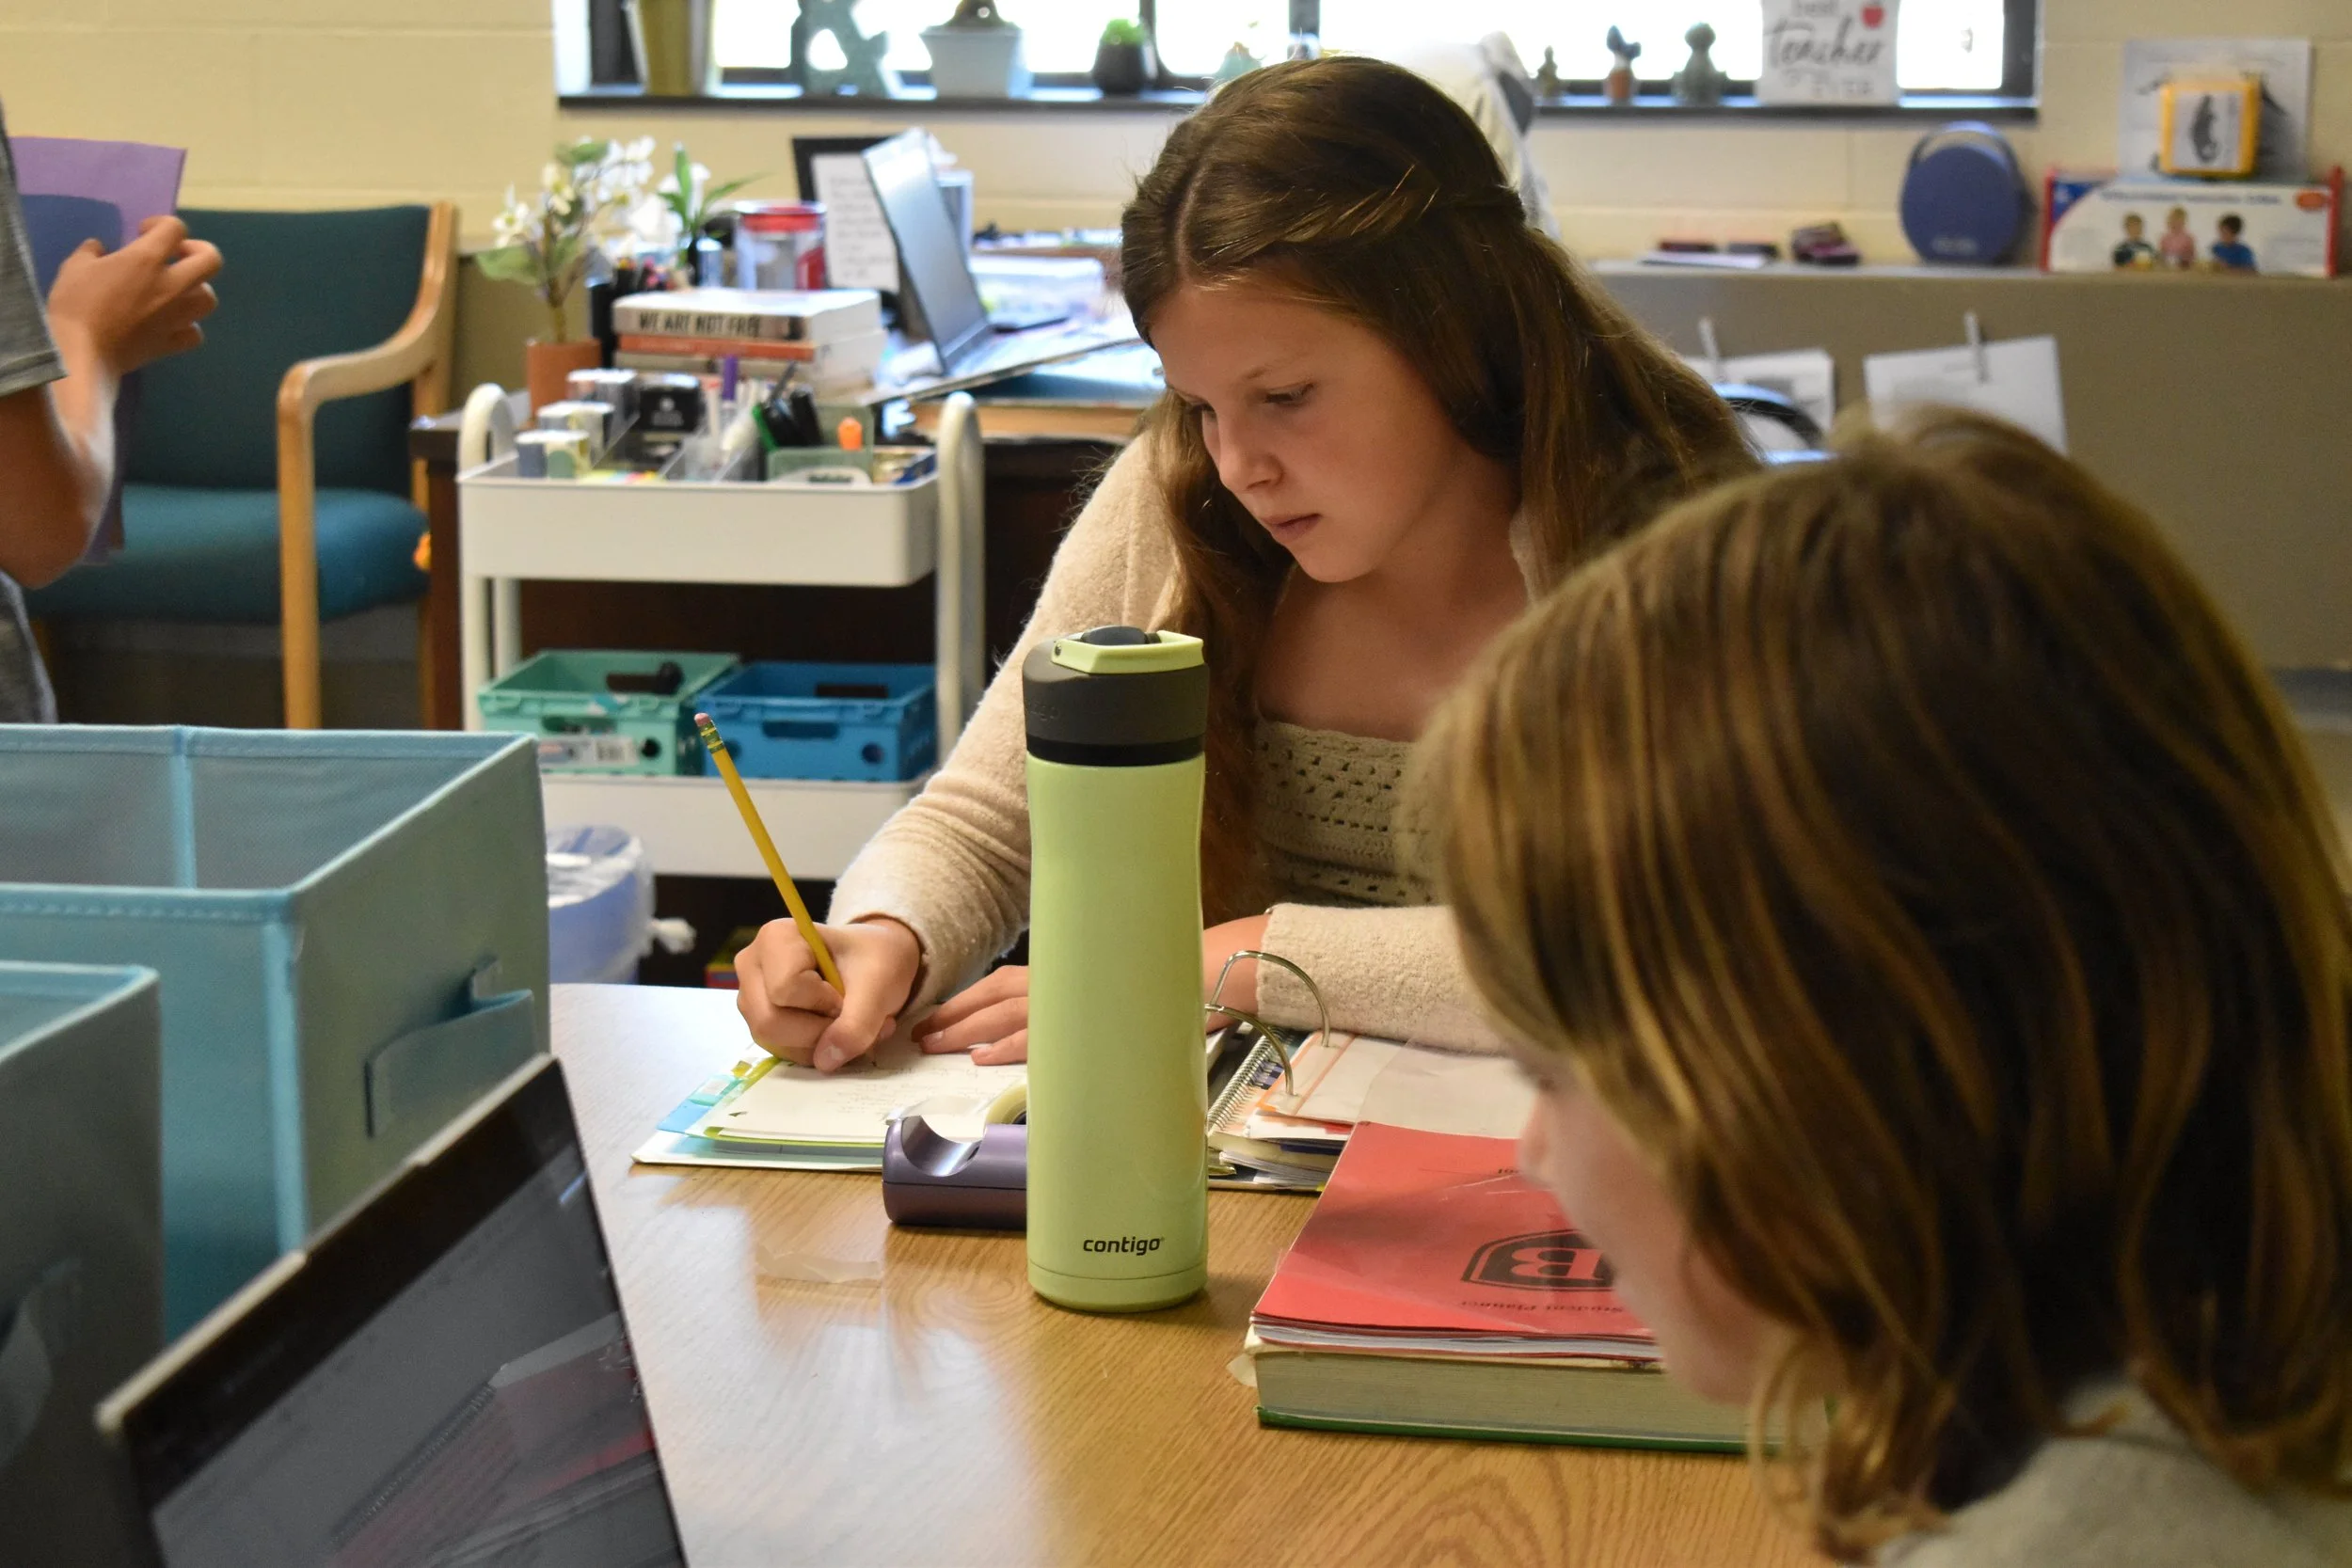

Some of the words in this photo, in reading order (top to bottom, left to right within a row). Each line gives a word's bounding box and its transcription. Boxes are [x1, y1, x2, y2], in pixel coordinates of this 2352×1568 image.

[640, 311, 659, 330] WE
[664, 312, 690, 331] ARE
[696, 313, 723, 332] NOT
[728, 315, 761, 335] FREE
[1083, 1236, 1161, 1256] contigo
